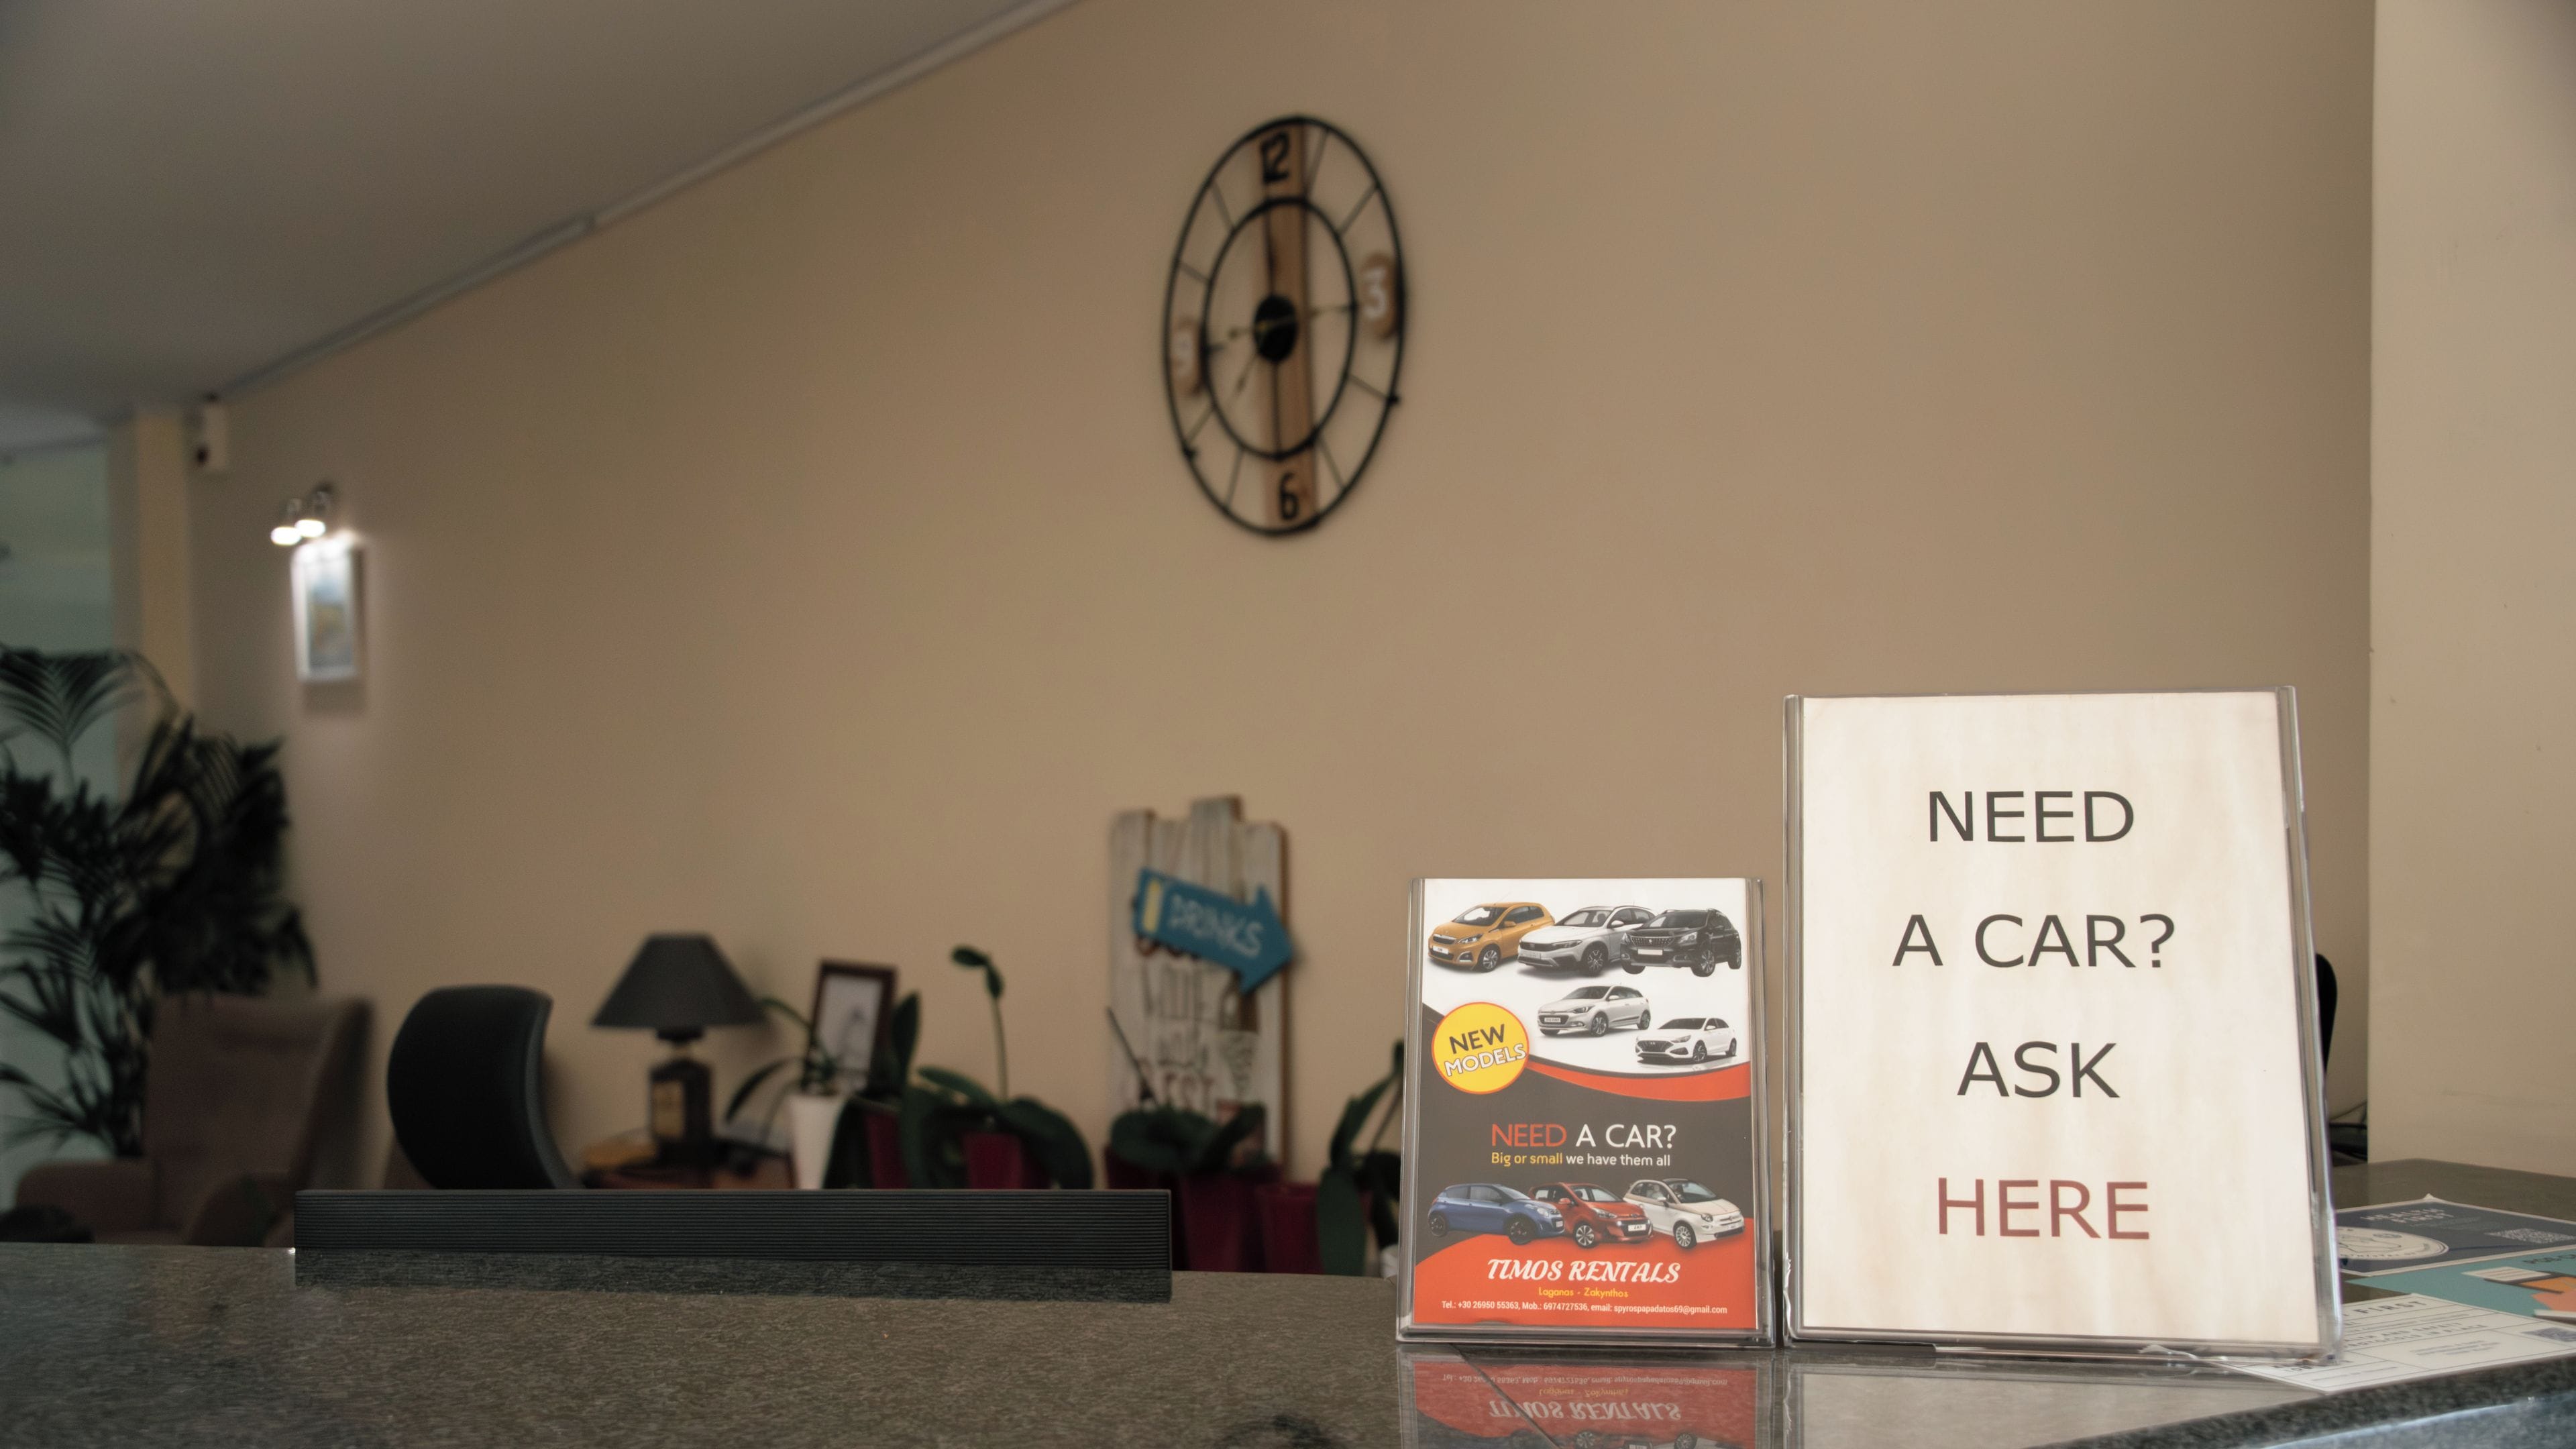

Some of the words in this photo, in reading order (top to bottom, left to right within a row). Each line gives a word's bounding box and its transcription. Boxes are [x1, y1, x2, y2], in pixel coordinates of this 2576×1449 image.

[1929, 790, 2134, 843] NEED
[1892, 914, 1943, 967] A
[1975, 913, 2175, 968] CAR?
[1449, 1024, 1505, 1054] NEW
[1444, 1043, 1526, 1077] MODELS
[1957, 1041, 2120, 1099] ASK
[1491, 1124, 1567, 1147] NEED
[1576, 1124, 1597, 1148] A
[1605, 1124, 1676, 1149] CAR?
[1491, 1152, 1511, 1167] Big
[1514, 1155, 1527, 1164] or
[1529, 1152, 1563, 1165] small
[1566, 1155, 1584, 1165] we
[1587, 1153, 1617, 1165] have
[1620, 1154, 1653, 1166] them
[1656, 1155, 1670, 1167] all
[1938, 1177, 2149, 1240] HERE
[1487, 1258, 1564, 1281] TIMOS
[1568, 1260, 1681, 1283] RENTALS
[1442, 1301, 1456, 1309] Tel.:
[1497, 1301, 1521, 1310] 55363,
[1522, 1302, 1542, 1310] Mob.:
[1544, 1302, 1589, 1311] 6974727536,
[1591, 1303, 1613, 1311] email:
[1613, 1304, 1727, 1314] spyrospapadatos69@gmail.com
[1538, 1287, 1574, 1298] Laganas
[1584, 1287, 1629, 1299] Zakynthos
